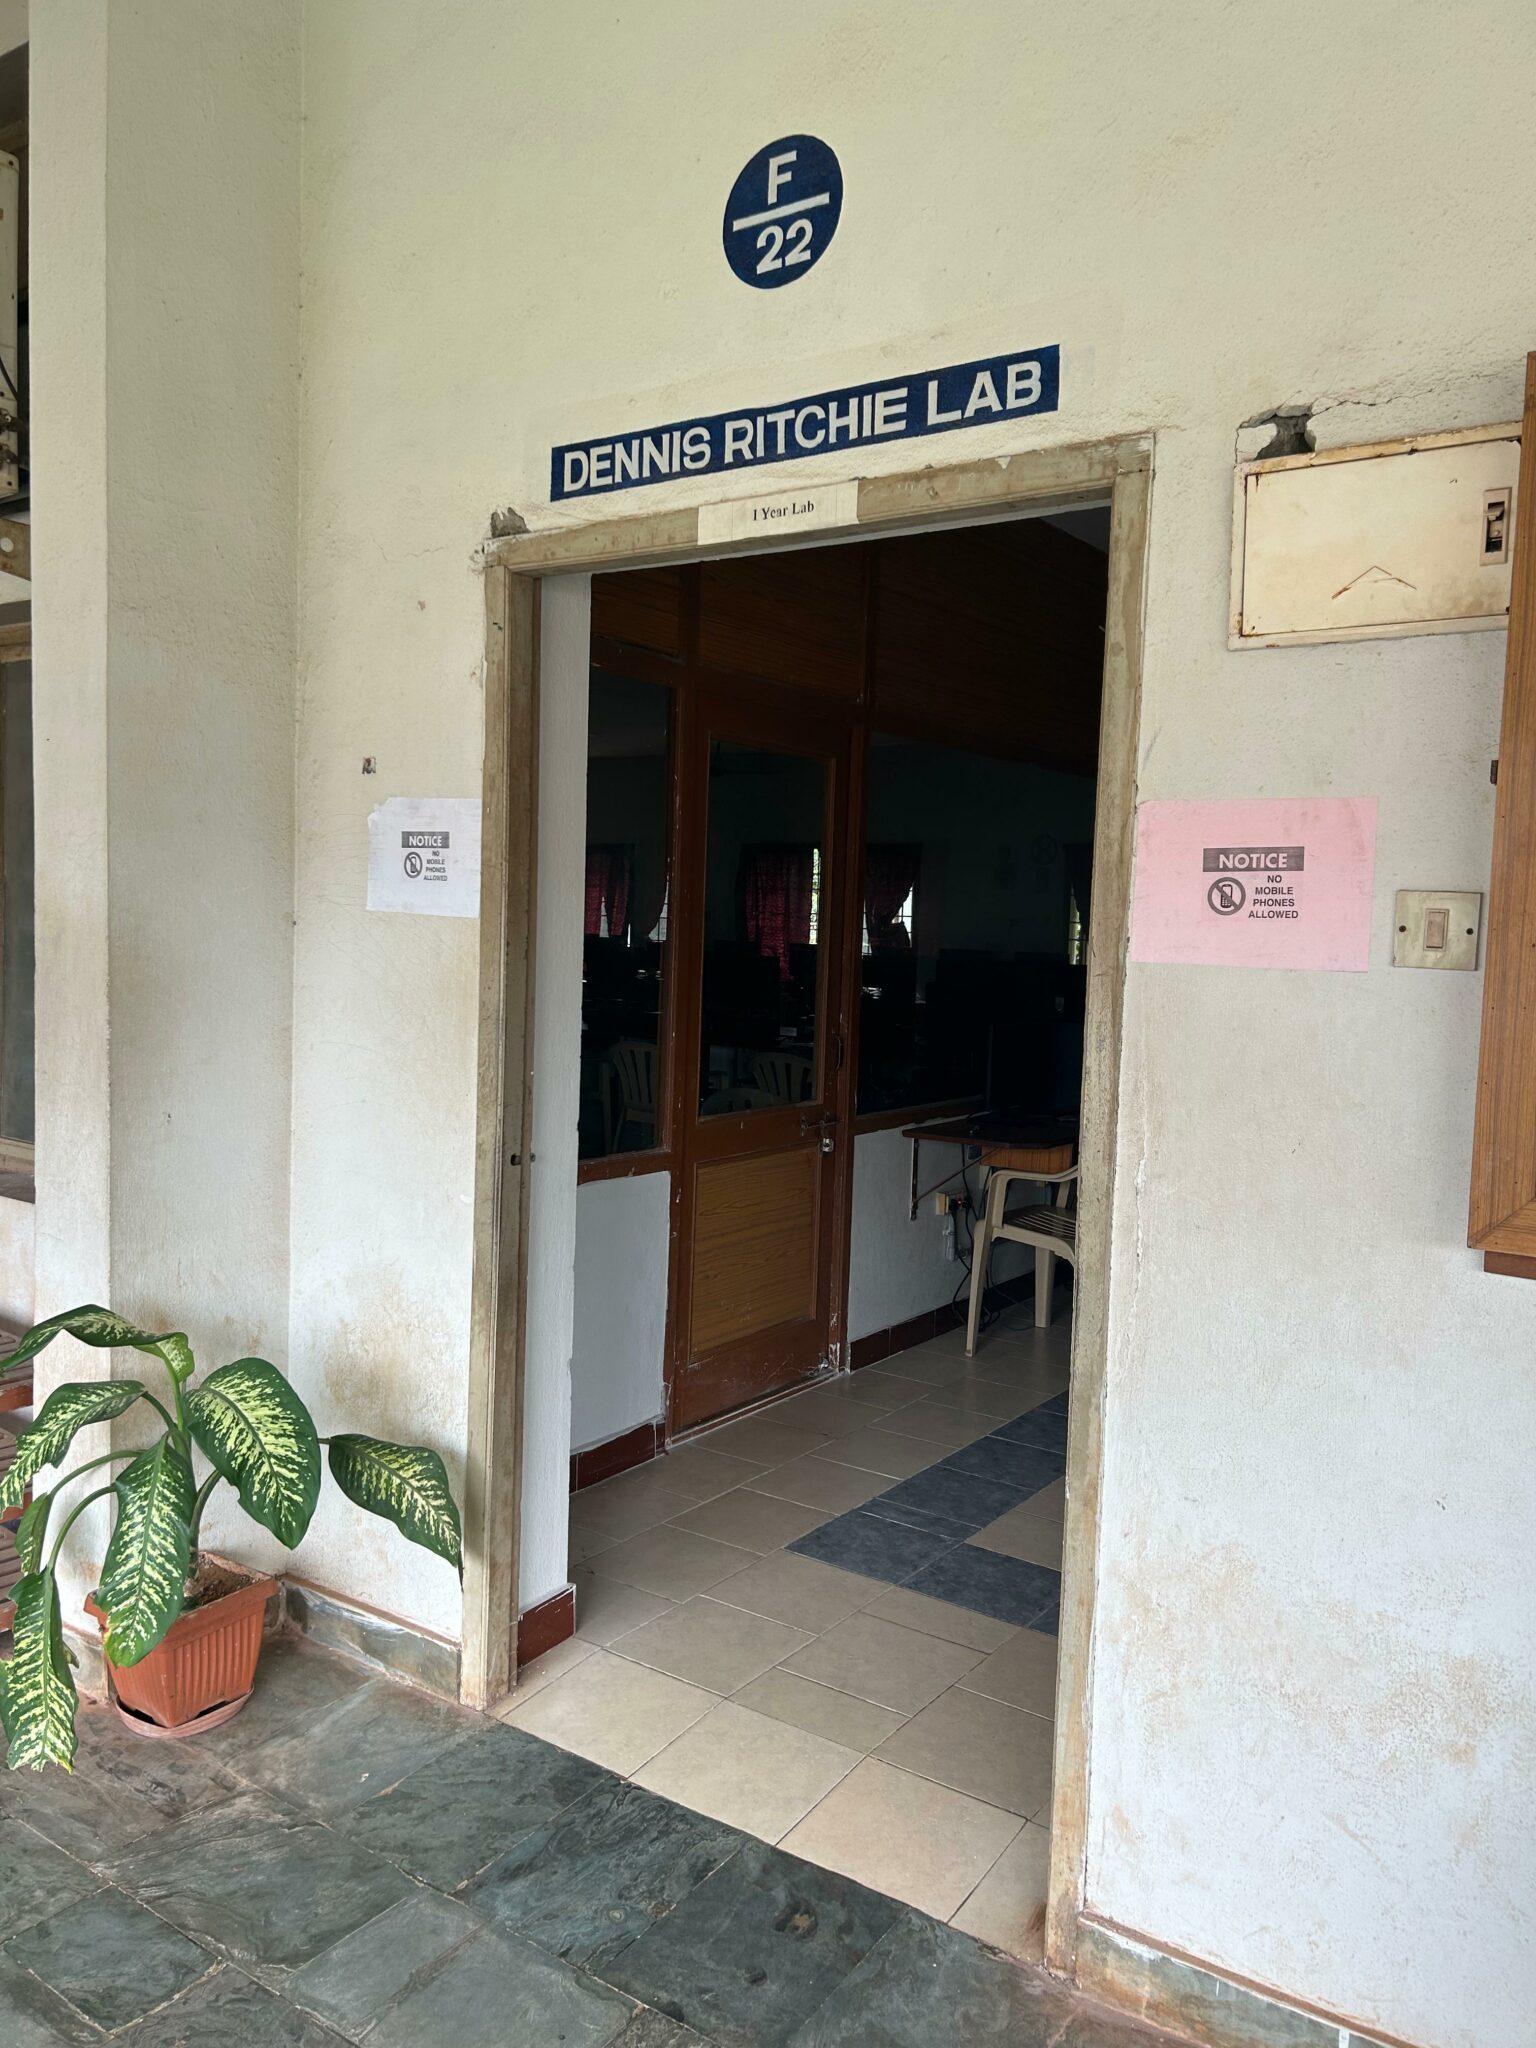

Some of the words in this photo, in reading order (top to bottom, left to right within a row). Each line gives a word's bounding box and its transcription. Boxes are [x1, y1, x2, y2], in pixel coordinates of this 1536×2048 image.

[767, 150, 797, 205] F
[756, 218, 812, 274] 22
[562, 426, 711, 493] DENNIS
[724, 387, 908, 464] RITCHIE
[927, 360, 1043, 426] LAB
[760, 504, 789, 519] Year
[791, 500, 815, 516] Lab
[408, 835, 443, 847] NOTICE
[1218, 853, 1289, 870] NOTICE
[1267, 874, 1283, 884] NO
[1254, 886, 1294, 896] MOBILE
[1252, 898, 1295, 907] PHONES
[1248, 910, 1299, 919] ALLOWED
